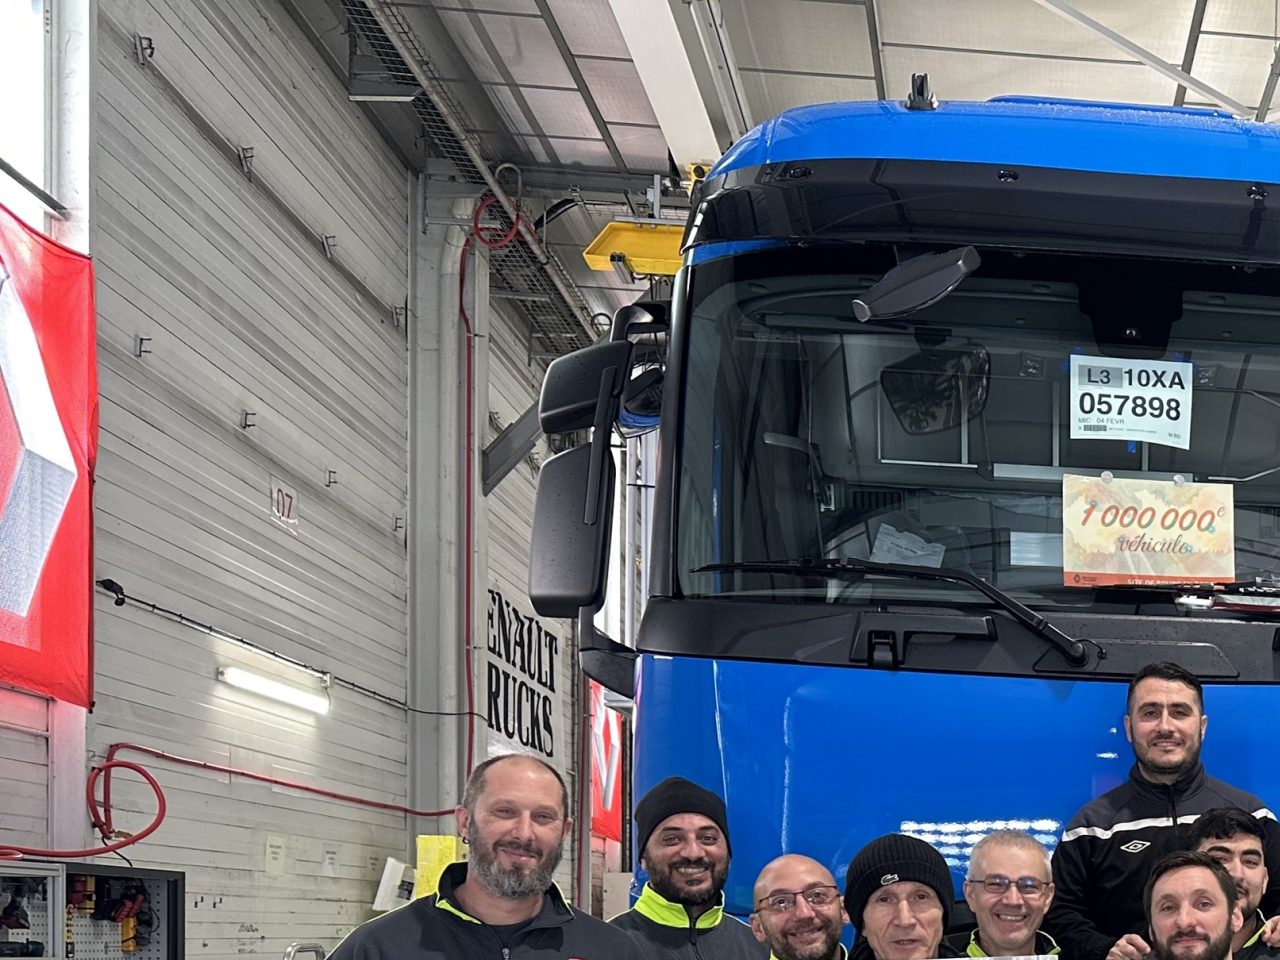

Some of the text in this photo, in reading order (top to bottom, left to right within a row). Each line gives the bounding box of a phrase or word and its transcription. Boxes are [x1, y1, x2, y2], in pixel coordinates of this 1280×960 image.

[1087, 367, 1186, 390] L3 10XA
[1078, 391, 1181, 421] 057898
[276, 487, 293, 519] 07
[1119, 533, 1189, 556] véhicule
[488, 589, 558, 693] ENAULT
[488, 660, 553, 757] RUCKS
